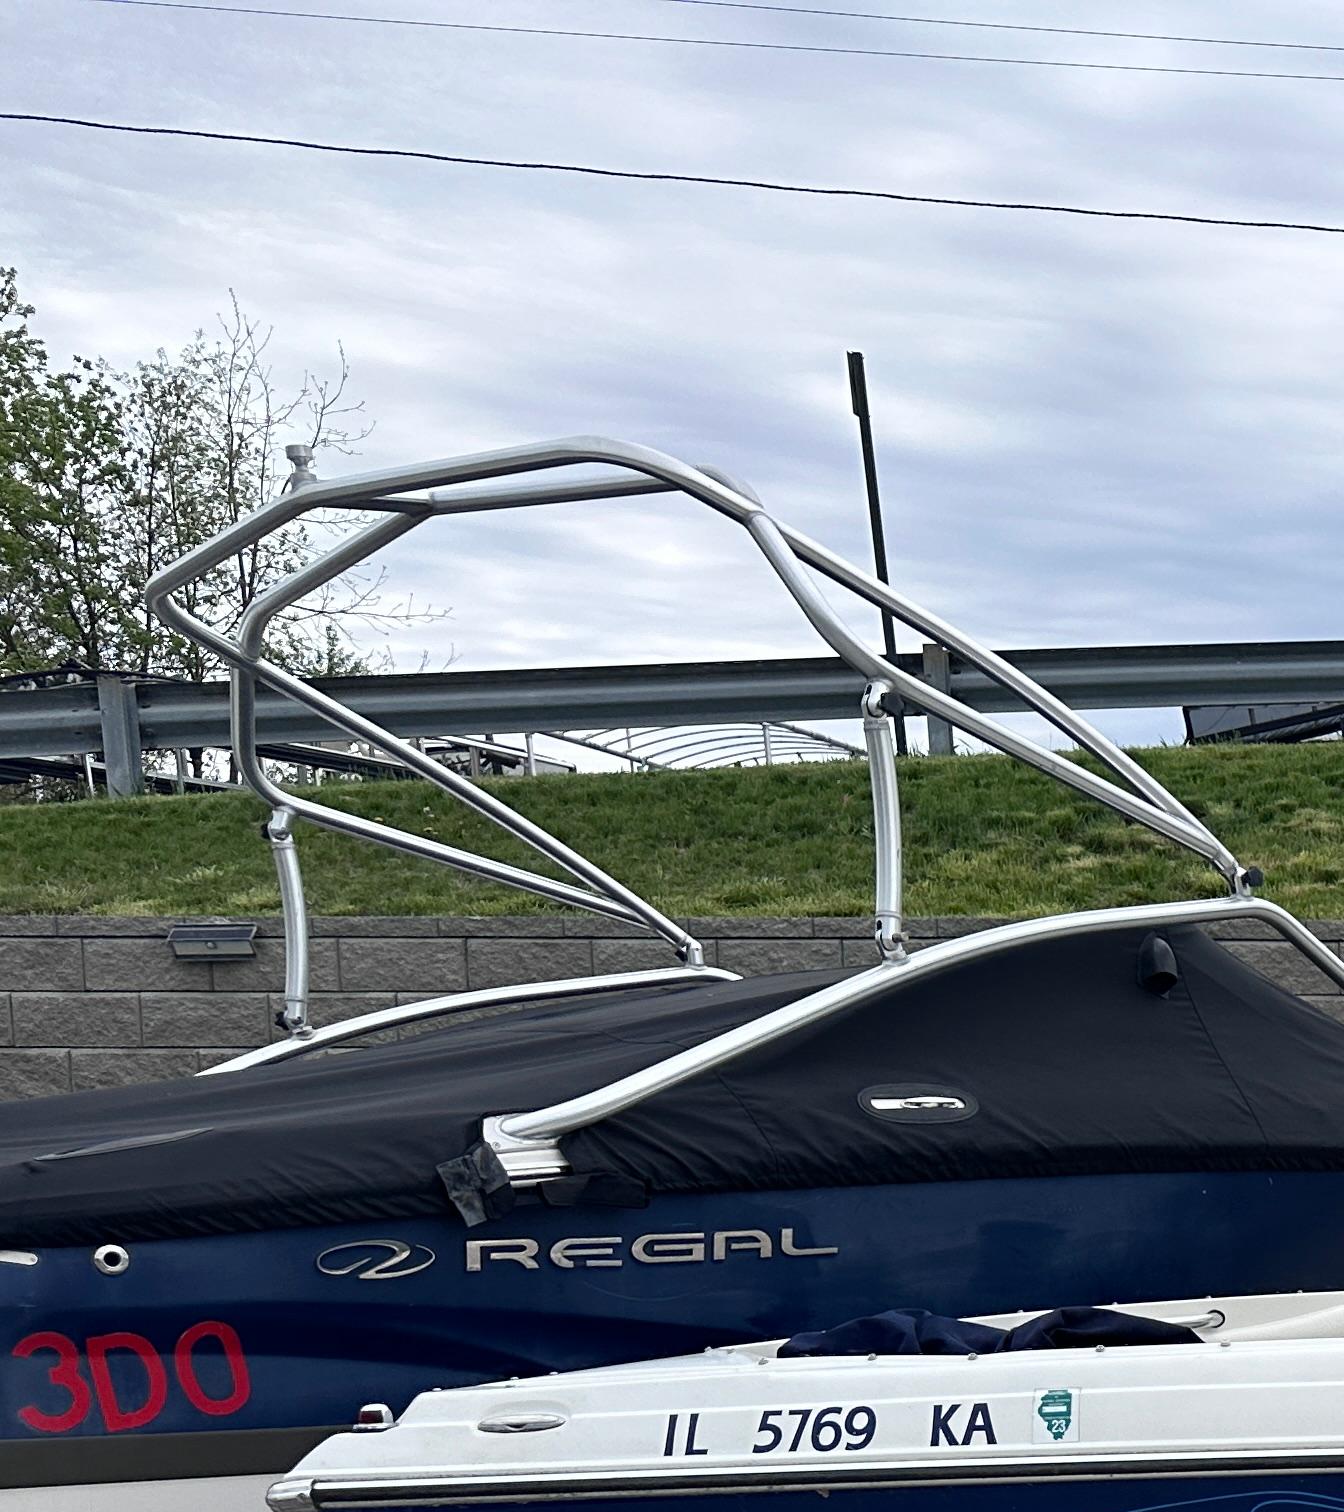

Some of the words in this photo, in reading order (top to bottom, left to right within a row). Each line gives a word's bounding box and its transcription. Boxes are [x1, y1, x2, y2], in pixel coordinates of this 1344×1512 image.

[465, 1228, 839, 1272] REGAL
[663, 1413, 709, 1457] IL
[752, 1406, 877, 1454] 5769
[929, 1402, 998, 1448] KA
[1051, 1419, 1066, 1433] 23
